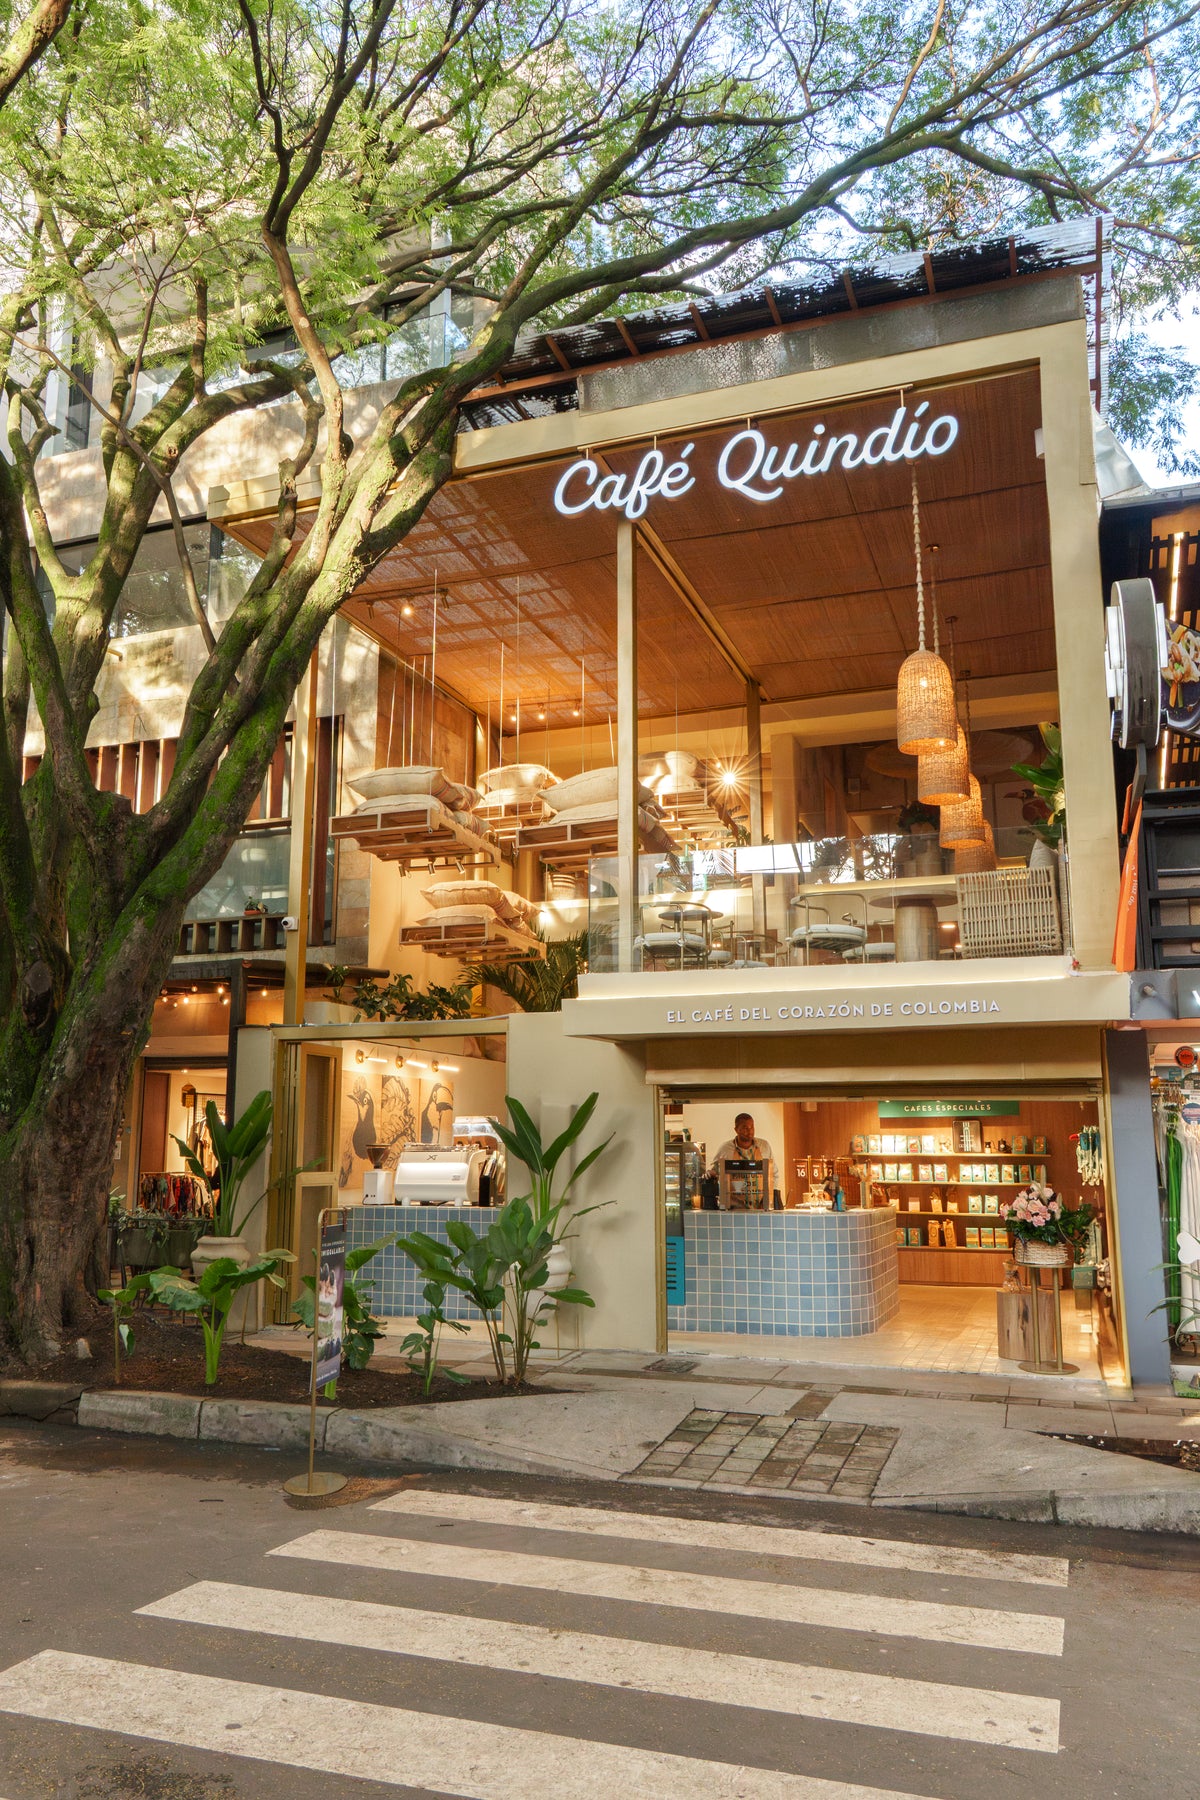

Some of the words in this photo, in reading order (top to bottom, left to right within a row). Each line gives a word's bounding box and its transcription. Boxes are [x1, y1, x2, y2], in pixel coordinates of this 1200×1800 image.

[553, 441, 697, 520] Café
[718, 400, 960, 502] Quindío
[666, 1010, 686, 1024] EL
[690, 1004, 734, 1023] CAFÉ
[739, 1006, 772, 1021] DEL
[777, 999, 866, 1020] CORAZÓN
[871, 1002, 894, 1017] DE
[899, 998, 1001, 1015] COLOMBIA
[796, 1168, 806, 1178] 16
